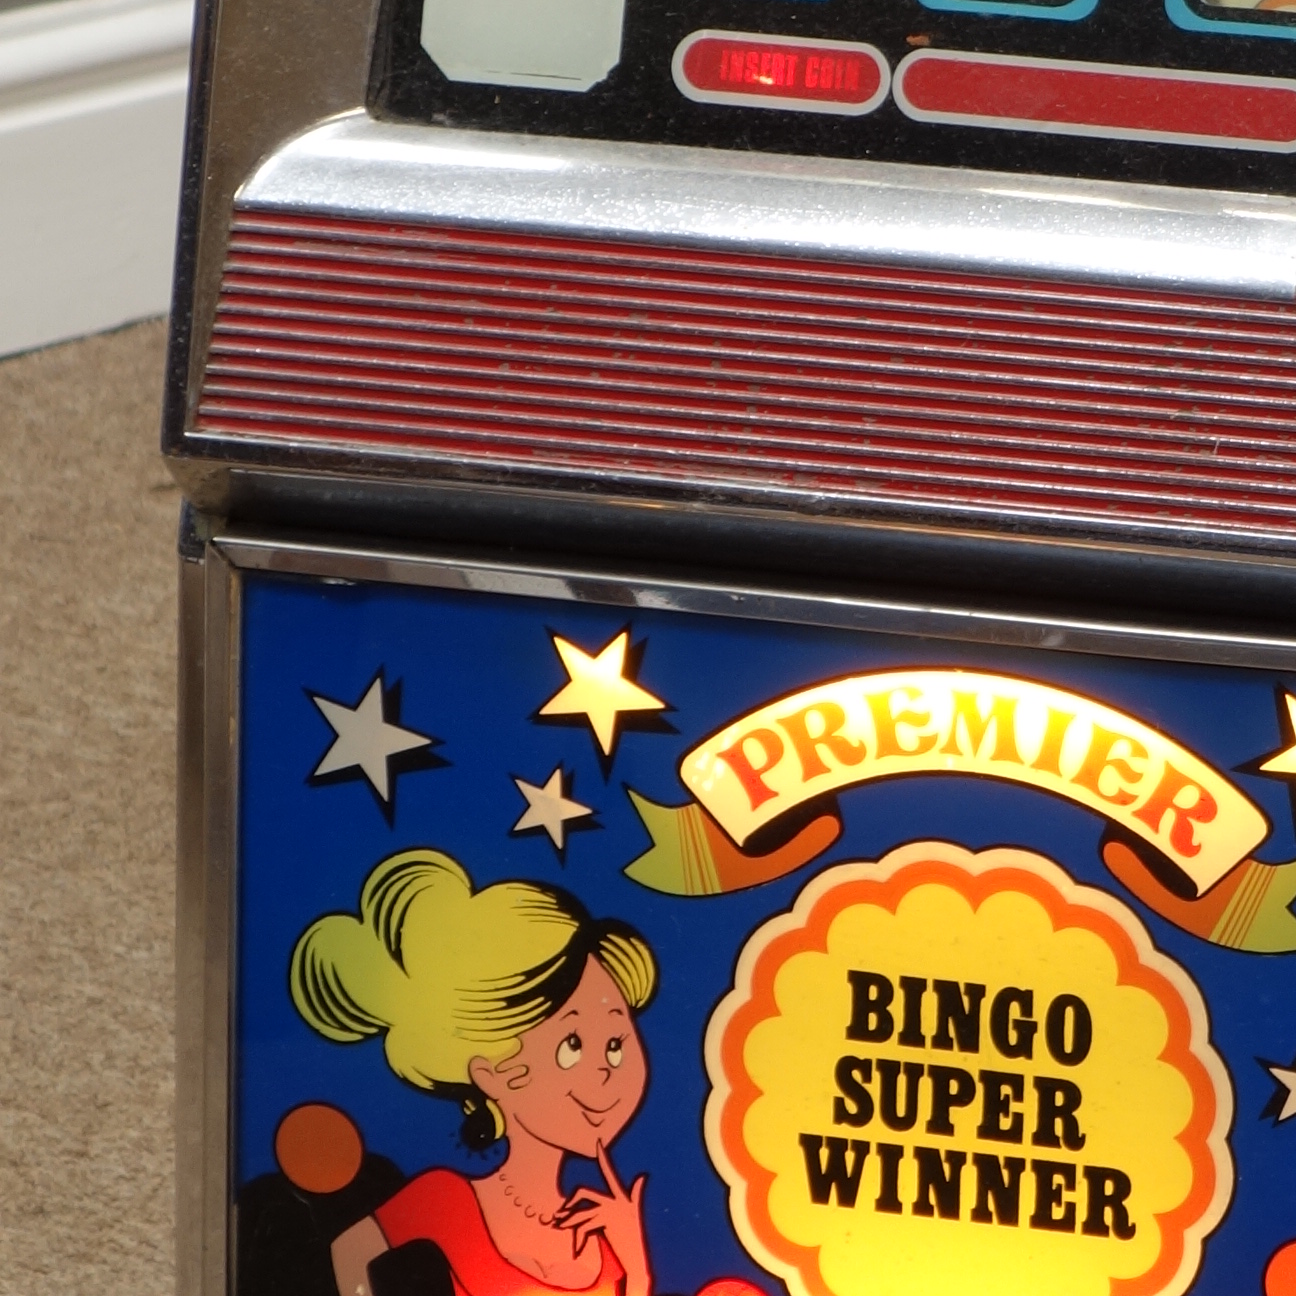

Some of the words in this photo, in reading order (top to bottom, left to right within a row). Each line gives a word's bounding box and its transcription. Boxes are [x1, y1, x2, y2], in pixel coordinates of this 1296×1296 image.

[719, 49, 799, 86] INSERT
[805, 56, 861, 91] COIN
[716, 684, 1220, 859] PREMIER
[844, 969, 1094, 1067] BINGO
[832, 1055, 1087, 1151] SUPER
[798, 1133, 1137, 1242] WINNER
